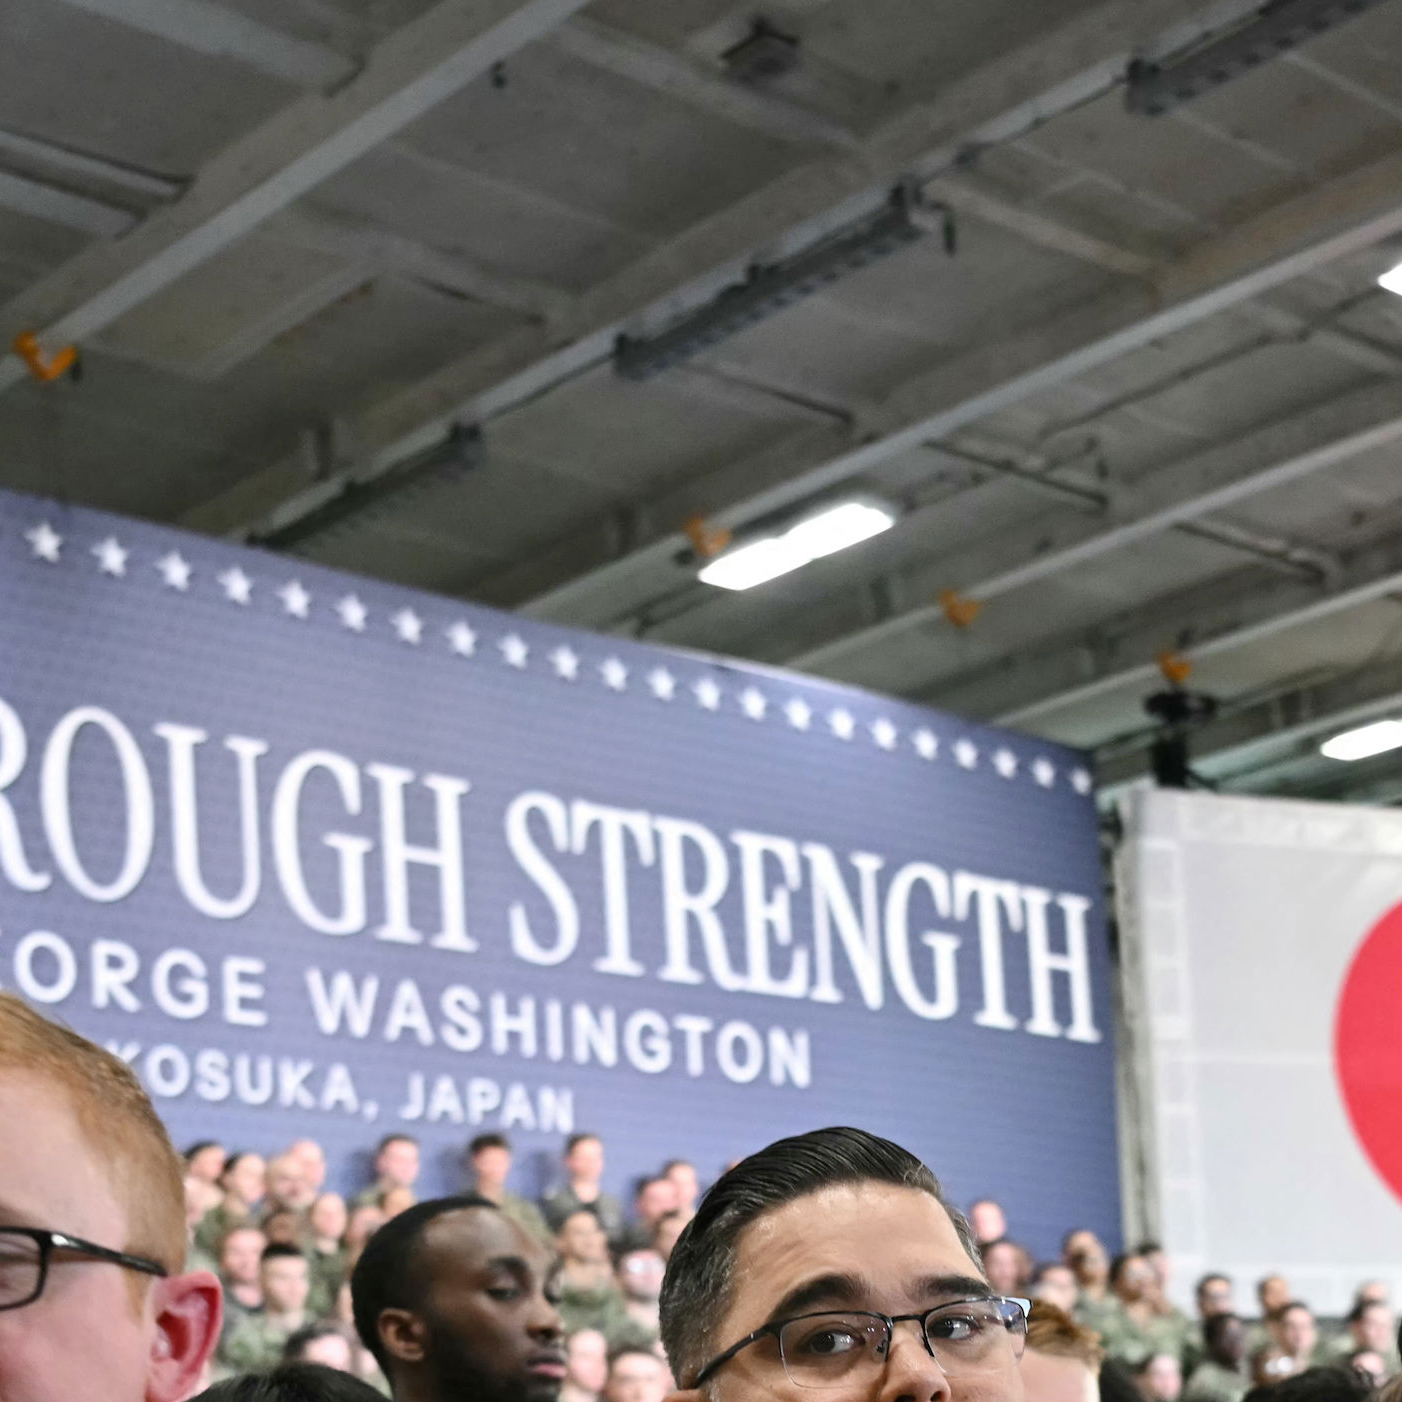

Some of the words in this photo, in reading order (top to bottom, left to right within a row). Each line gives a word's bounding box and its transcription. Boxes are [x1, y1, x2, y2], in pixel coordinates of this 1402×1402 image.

[504, 790, 1103, 1044] STRENGTH
[304, 966, 811, 1088] WASHINGTON
[401, 1072, 574, 1133] JAPAN
